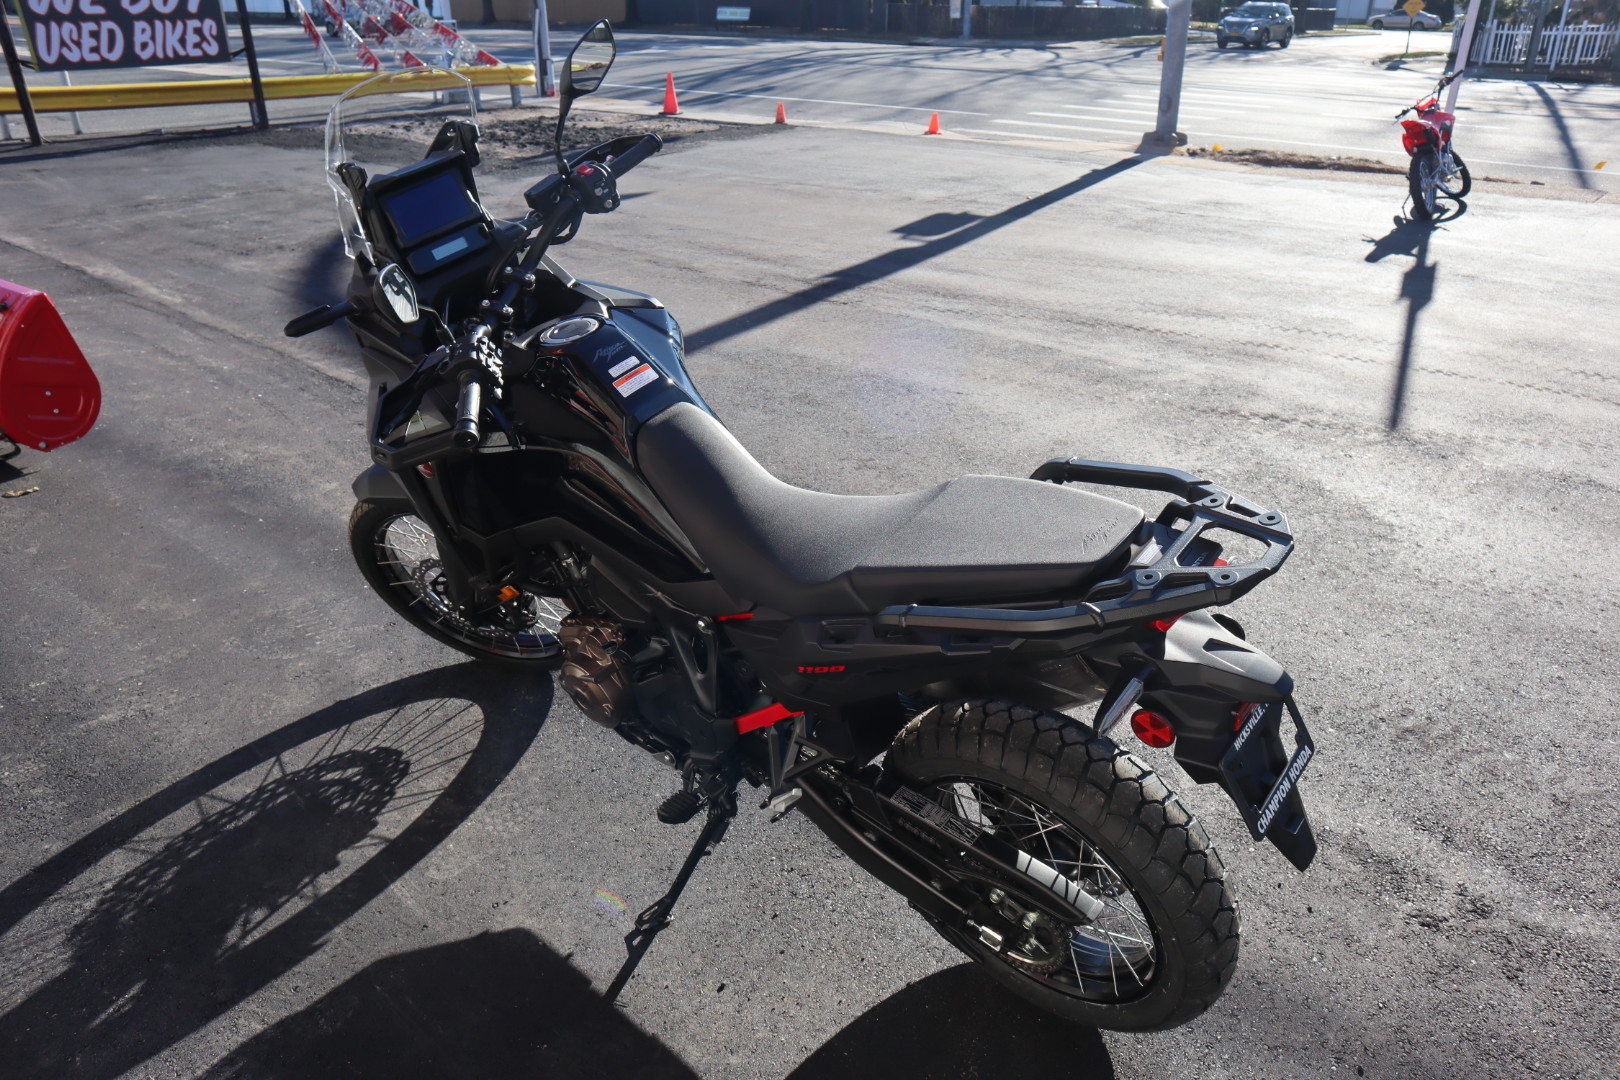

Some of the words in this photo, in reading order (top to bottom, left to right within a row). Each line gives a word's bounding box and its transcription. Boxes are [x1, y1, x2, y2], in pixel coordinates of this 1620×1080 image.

[35, 20, 124, 64] USED
[133, 18, 220, 60] BIKES
[797, 665, 846, 673] 1100
[1233, 705, 1266, 751] HICKSVILLE,
[1257, 777, 1291, 834] CHAMPION
[1288, 745, 1312, 783] HONDA
